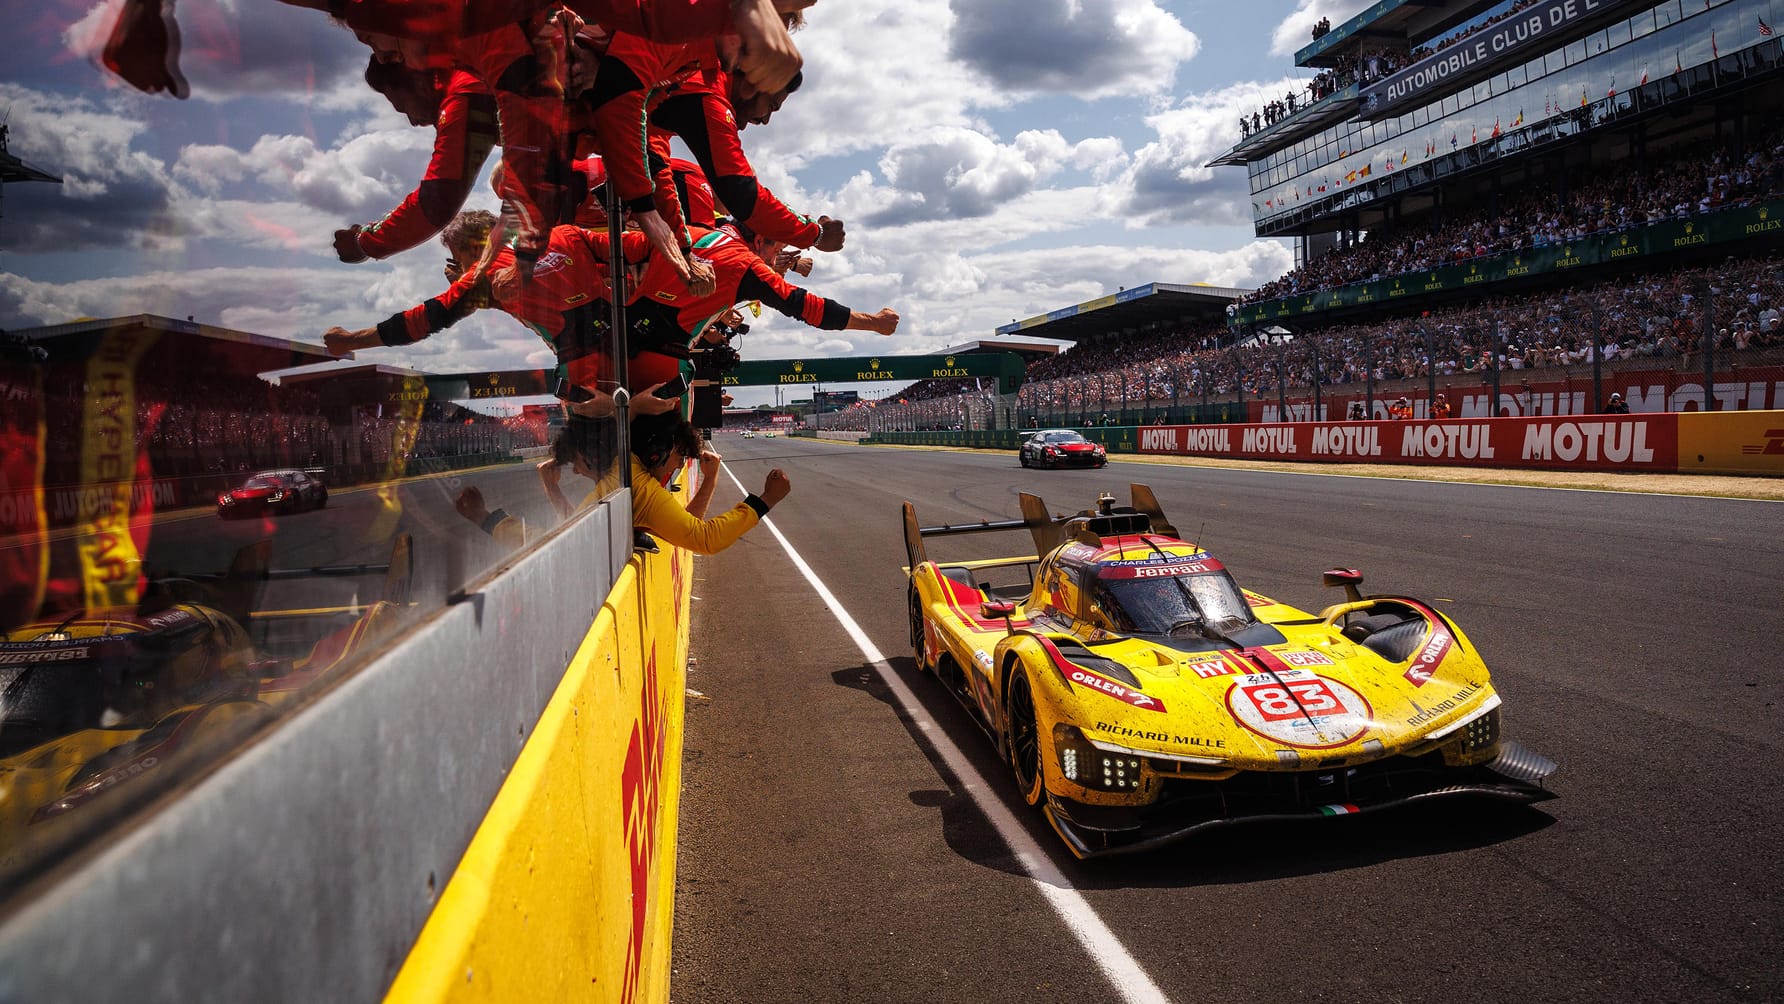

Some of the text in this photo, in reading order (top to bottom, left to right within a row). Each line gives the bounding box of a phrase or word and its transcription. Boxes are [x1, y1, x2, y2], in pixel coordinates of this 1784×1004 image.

[1387, 42, 1488, 101] AUTOMOBILE
[1492, 15, 1543, 52] CLUB
[1549, 0, 1578, 27] DE
[1746, 219, 1782, 234] ROLEX
[1674, 234, 1705, 247] ROLEX
[1611, 245, 1639, 258] ROLEX
[1556, 256, 1581, 268] ROLEX
[1507, 265, 1528, 276] ROLEX
[1424, 281, 1443, 290] ROLEX
[1464, 274, 1484, 284] ROLEX
[1389, 288, 1406, 297] ROLEX
[780, 373, 817, 383] ROLEX
[857, 371, 893, 380] ROLEX
[933, 368, 968, 377] ROLEX
[1142, 429, 1178, 450] MOTUL
[1187, 428, 1231, 452] MOTUL
[1242, 427, 1297, 454] MOTUL
[1311, 426, 1382, 456] MOTUL
[1401, 424, 1495, 459] MOTUL
[1521, 421, 1654, 463] MOTUL
[1110, 555, 1197, 567] CHARLES POZZI
[1135, 562, 1211, 578] Ferrari
[1421, 633, 1449, 664] ORLEN
[1290, 656, 1332, 665] CAR
[1190, 660, 1229, 678] HY
[1072, 671, 1126, 698] ORLEN
[1253, 684, 1337, 715] 83
[1406, 680, 1482, 727] RICHARD MILLE
[1096, 721, 1226, 749] RICHARD MILLE
